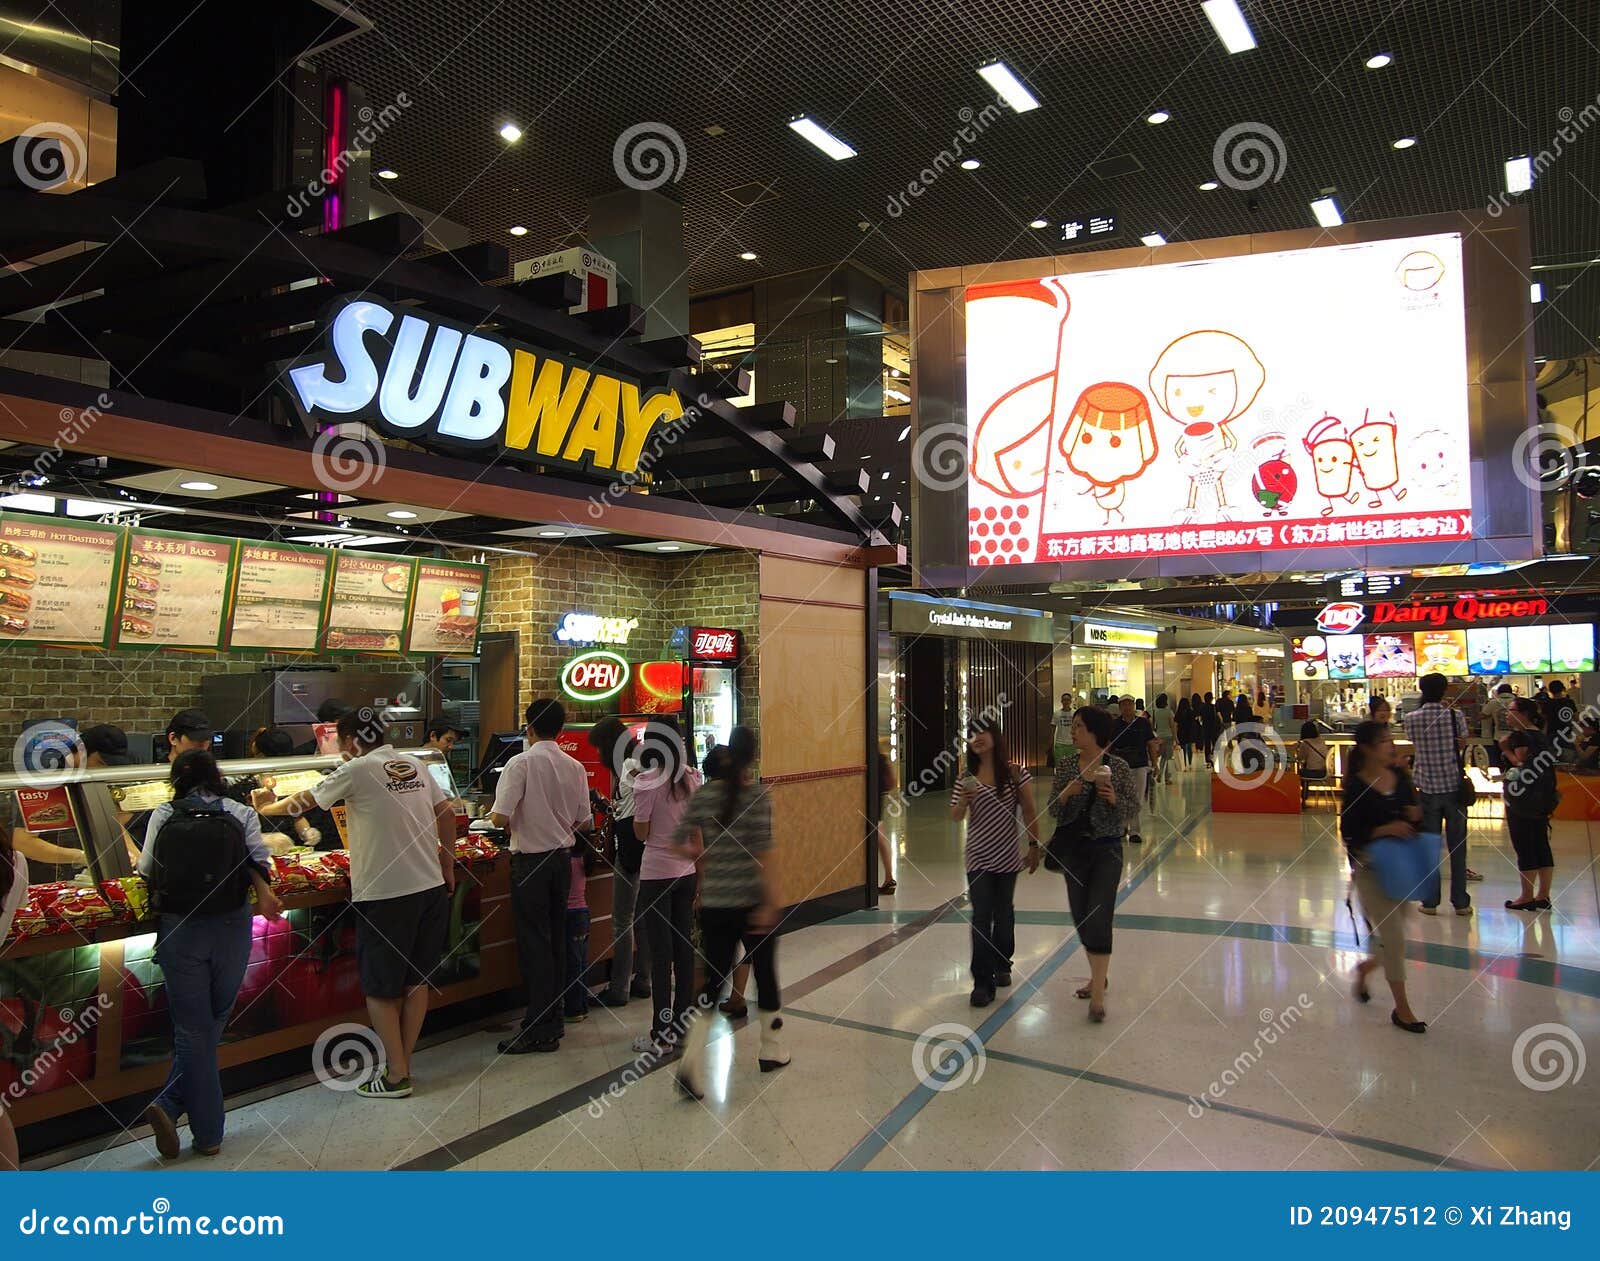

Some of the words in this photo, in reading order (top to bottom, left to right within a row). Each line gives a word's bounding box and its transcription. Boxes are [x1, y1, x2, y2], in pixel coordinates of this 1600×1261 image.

[289, 301, 685, 473] SUBWAY
[142, 540, 186, 554] 基本系列
[189, 546, 217, 557] BASICS
[359, 560, 385, 572] SALADS
[1371, 602, 1449, 626] Dairy
[1452, 597, 1548, 622] Queen
[694, 633, 737, 654] 可口可乐
[571, 663, 620, 688] OPEN
[19, 790, 49, 801] tasty
